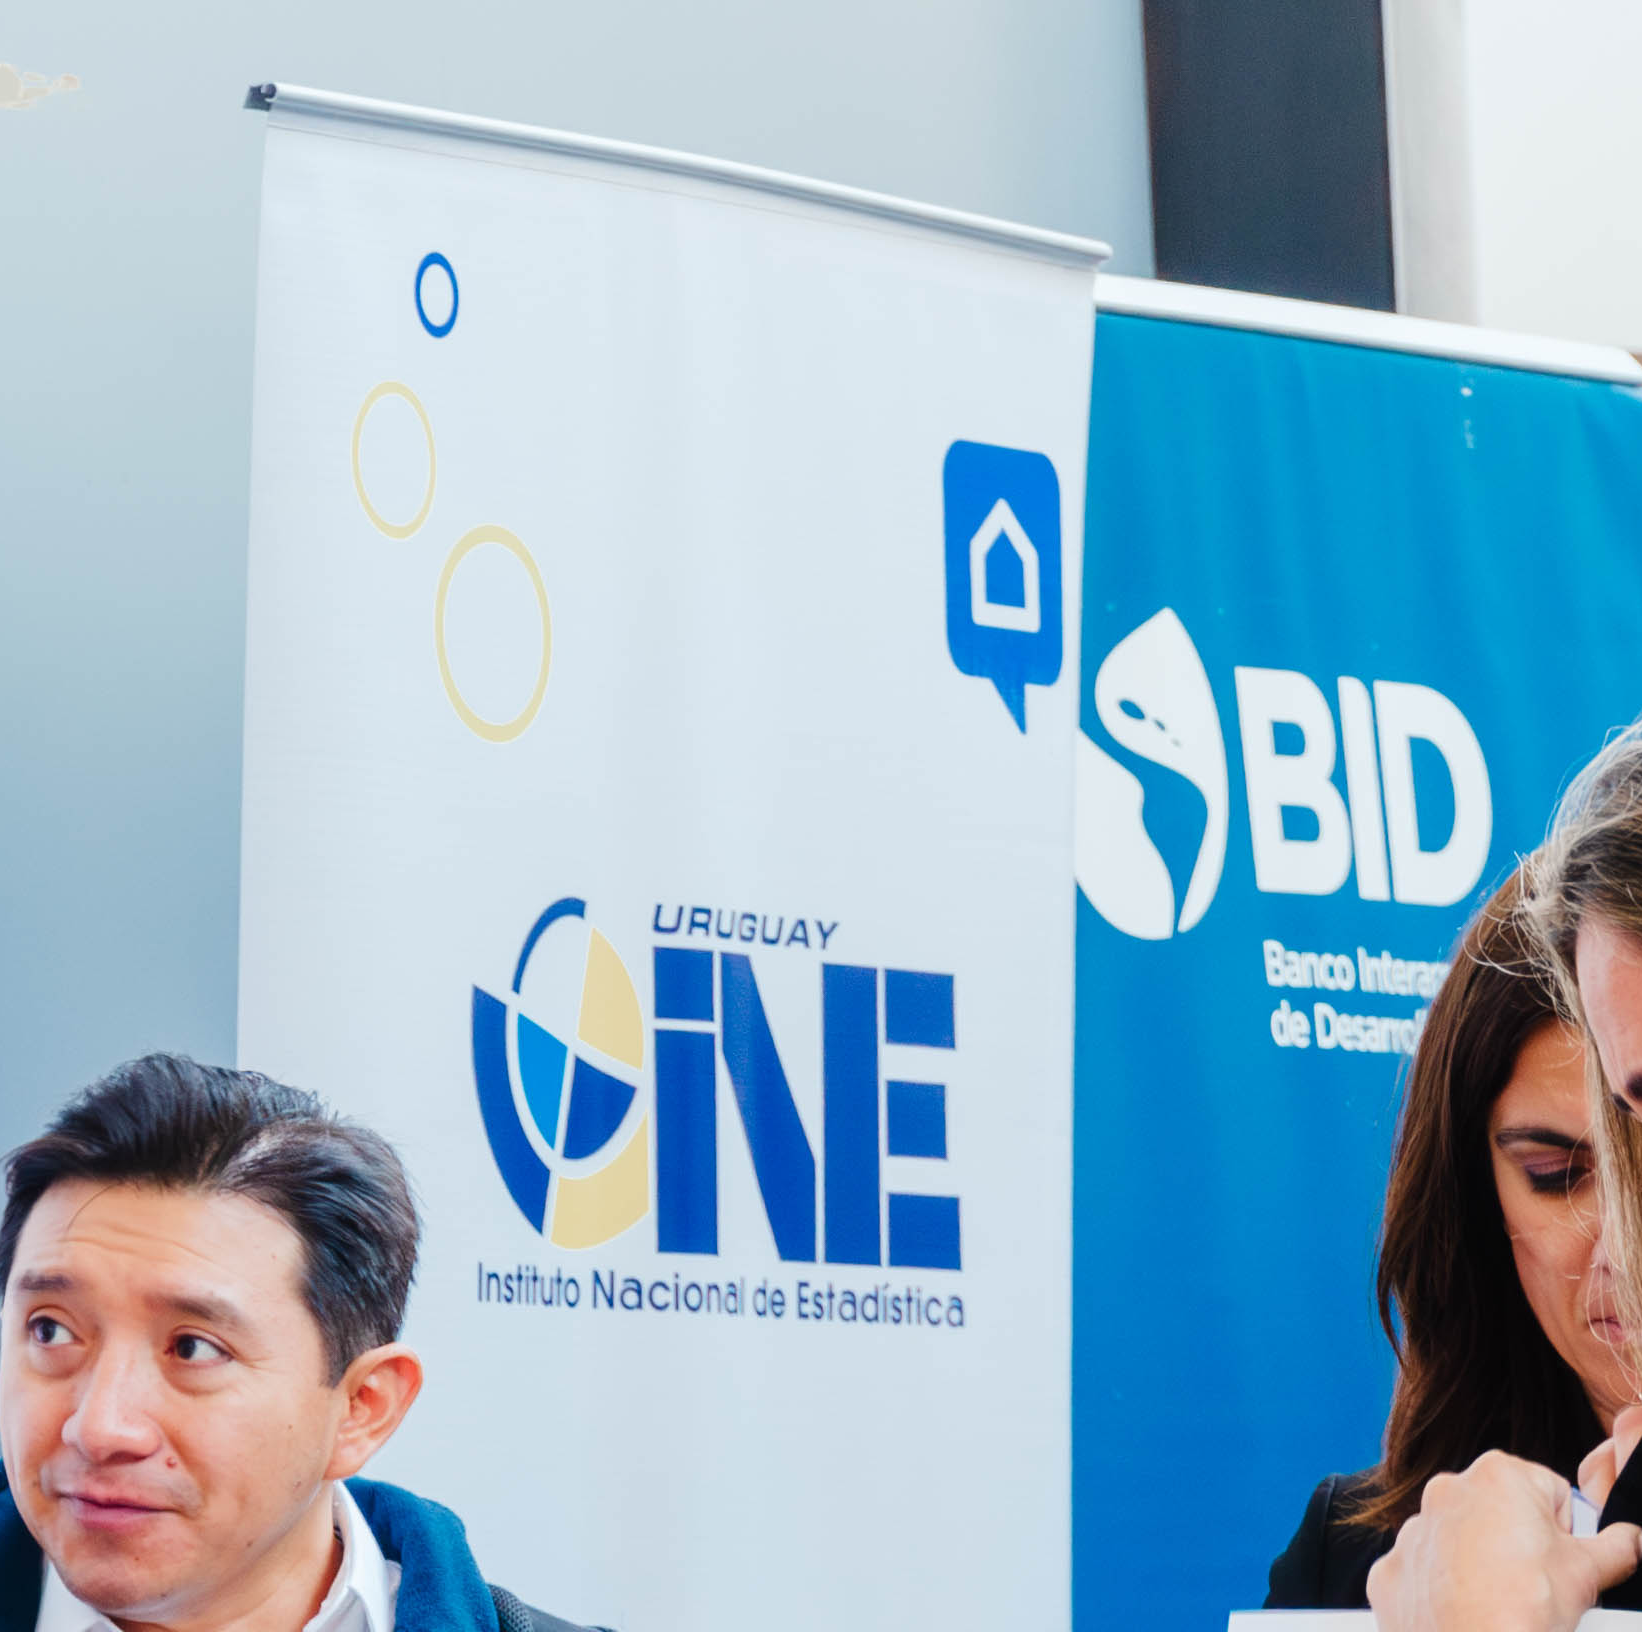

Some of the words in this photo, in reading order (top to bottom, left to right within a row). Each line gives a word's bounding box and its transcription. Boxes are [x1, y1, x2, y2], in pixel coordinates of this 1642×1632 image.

[1234, 665, 1493, 909] BID
[652, 903, 840, 950] URUGUAY
[1263, 938, 1356, 992] Banco
[1270, 999, 1311, 1049] de
[477, 1262, 581, 1309] Instituto
[592, 1268, 744, 1316] Nacional
[754, 1278, 786, 1319] de
[798, 1281, 966, 1328] Estadística
